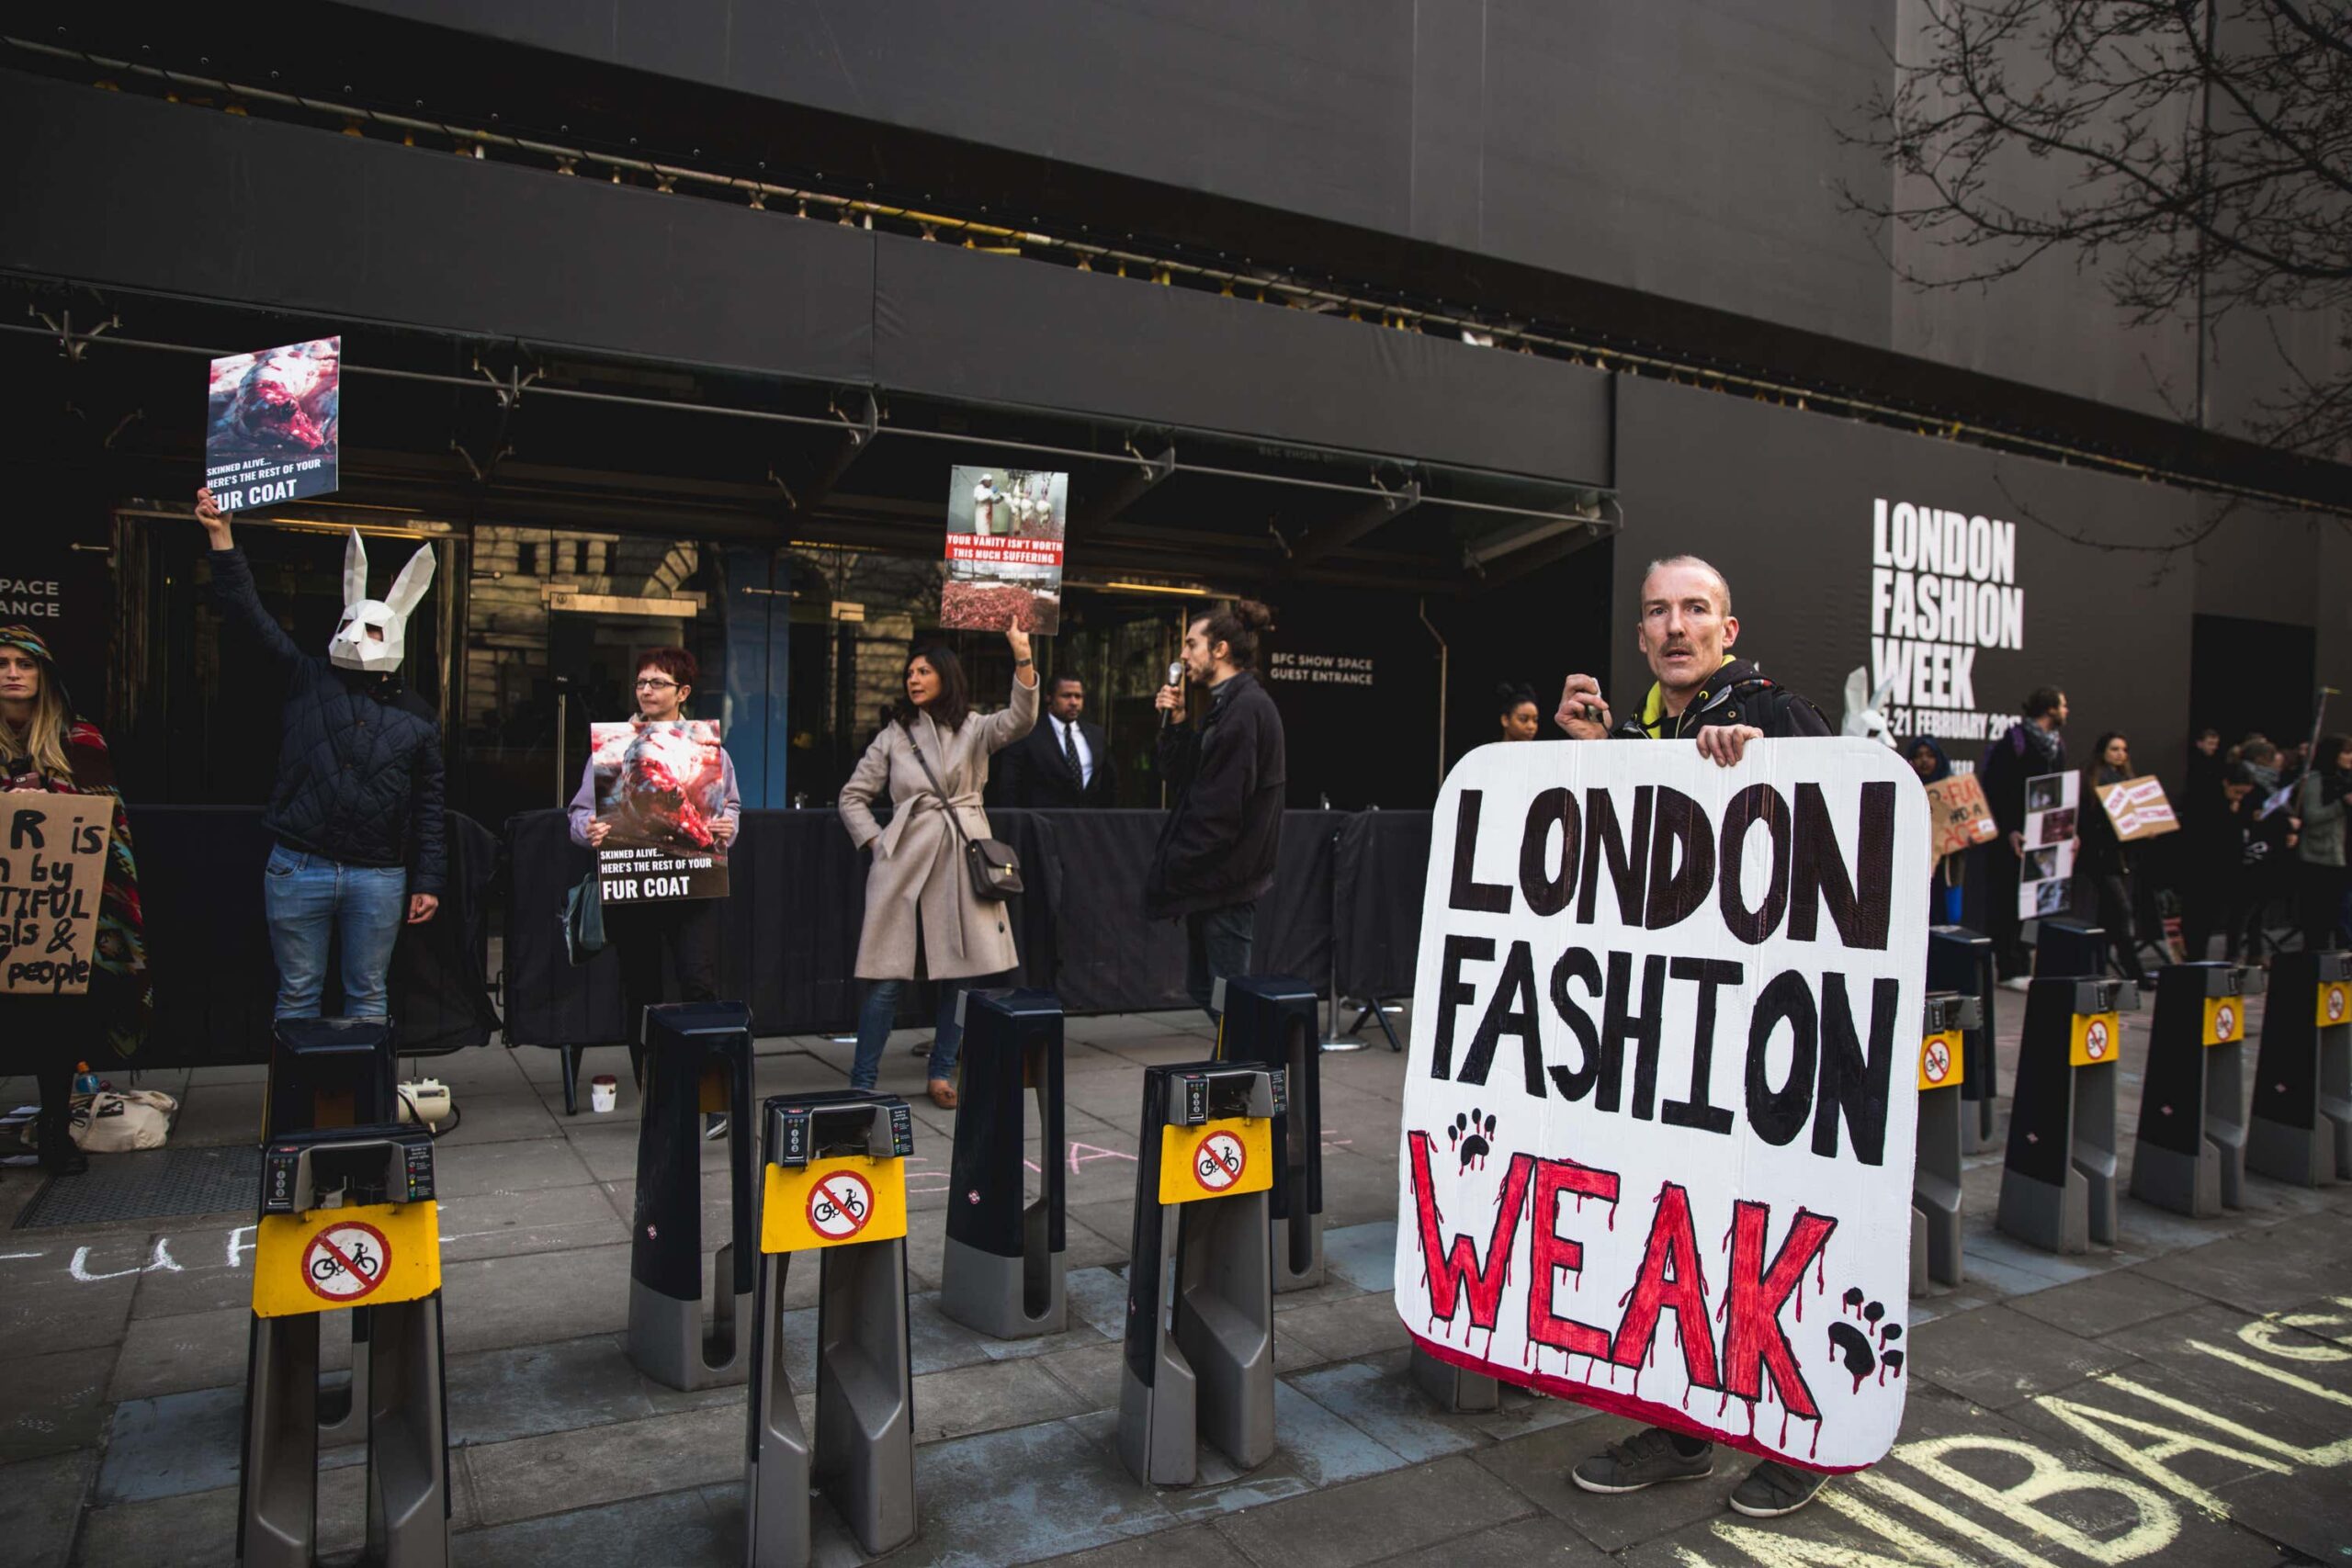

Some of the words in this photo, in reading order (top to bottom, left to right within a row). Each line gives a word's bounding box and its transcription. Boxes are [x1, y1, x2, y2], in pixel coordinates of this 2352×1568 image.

[207, 462, 241, 476] SKINNED
[243, 457, 272, 469] ALIVE...
[207, 475, 237, 489] HERE'S
[240, 471, 256, 482] THE
[258, 467, 280, 479] REST
[283, 464, 294, 474] OF
[296, 458, 321, 471] YOUR
[249, 479, 297, 504] COAT
[947, 535, 971, 546] YOUR
[974, 536, 1005, 547] VANITY
[1007, 538, 1030, 549] ISN'T
[1032, 540, 1063, 551] WORTH
[953, 547, 973, 558] THIS
[976, 548, 1001, 559] MUCH
[1002, 550, 1055, 563] SUFFERING
[1873, 498, 2016, 584] LONDON
[1871, 567, 2023, 649] FASHION
[1271, 668, 1310, 680] GUEST
[1312, 670, 1373, 684] ENTRANCE
[1272, 652, 1295, 664] BFC
[1298, 655, 1335, 667] SHOW
[1338, 658, 1373, 671] SPACE
[1871, 637, 1975, 710] WEEK
[1916, 709, 1988, 740] FEBRUARY
[1989, 713, 2022, 741] 20
[72, 817, 105, 854] is
[600, 849, 634, 860] SKINNED
[636, 848, 664, 858] ALIVE...
[601, 863, 631, 874] HERE'S
[634, 861, 650, 872] THE
[652, 860, 673, 871] REST
[675, 859, 686, 870] OF
[688, 858, 712, 868] YOUR
[1448, 781, 1897, 950] LONDON
[31, 852, 74, 894] by
[603, 879, 639, 900] FUR
[643, 876, 690, 897] COAT
[46, 918, 77, 953] &
[8, 953, 89, 995] people
[1430, 934, 1899, 1167] FASHION
[1406, 1130, 1838, 1422] WEAK
